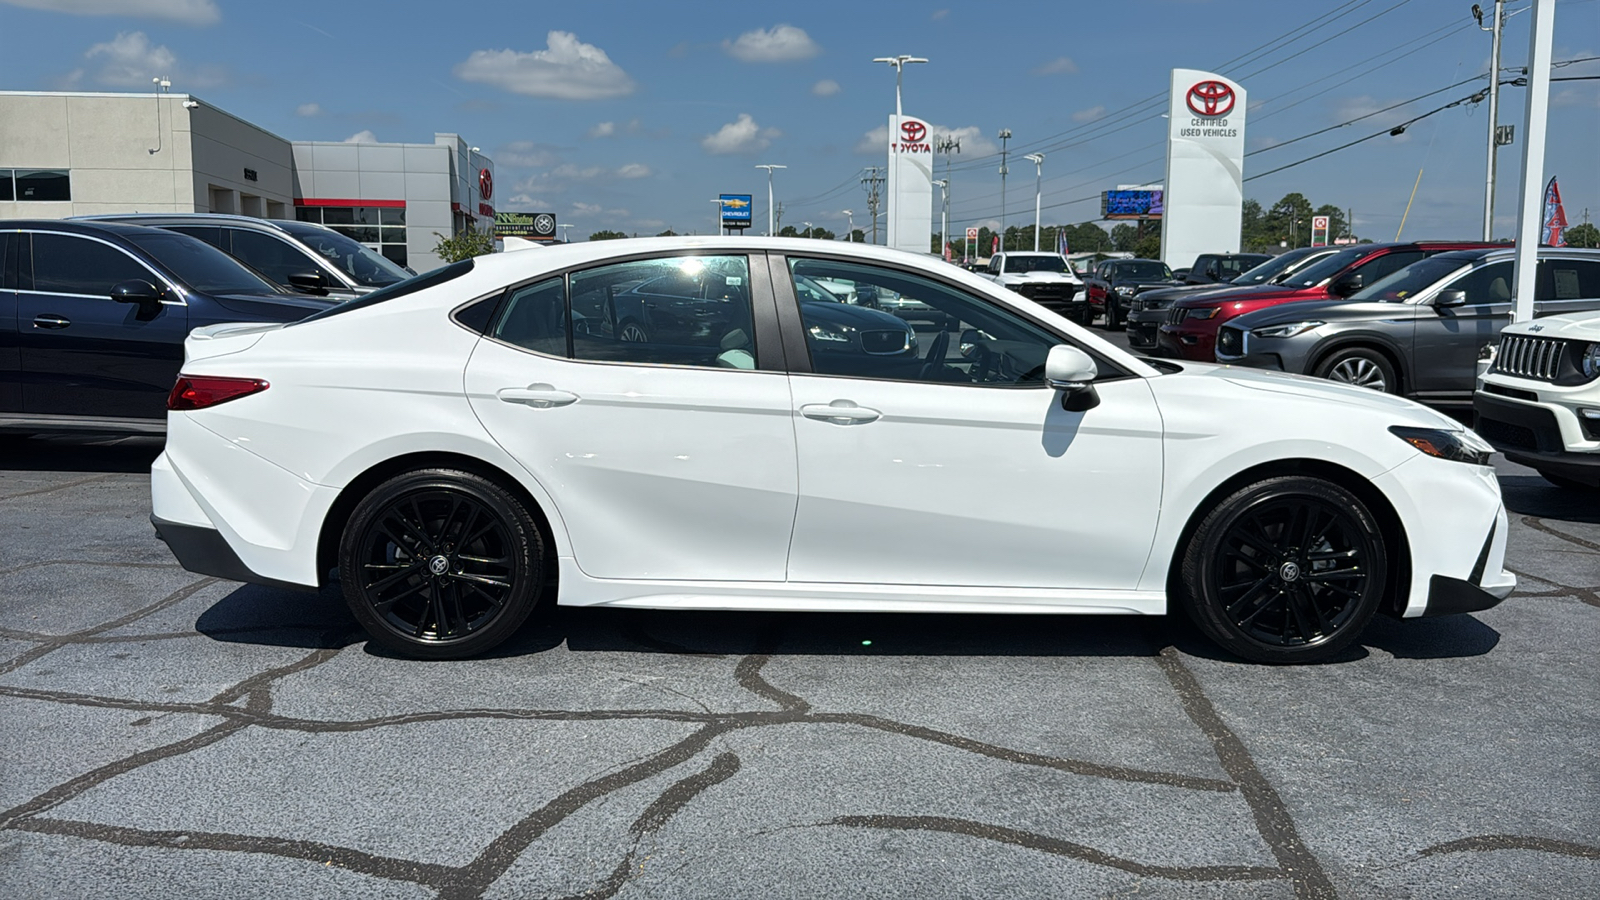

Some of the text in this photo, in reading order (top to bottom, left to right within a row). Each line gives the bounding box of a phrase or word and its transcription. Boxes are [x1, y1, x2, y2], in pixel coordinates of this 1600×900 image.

[1191, 118, 1228, 127] CERTIFIED
[1180, 128, 1237, 137] USED VEHICLES
[513, 214, 533, 224] Roofing
[507, 507, 530, 576] TURANZA
